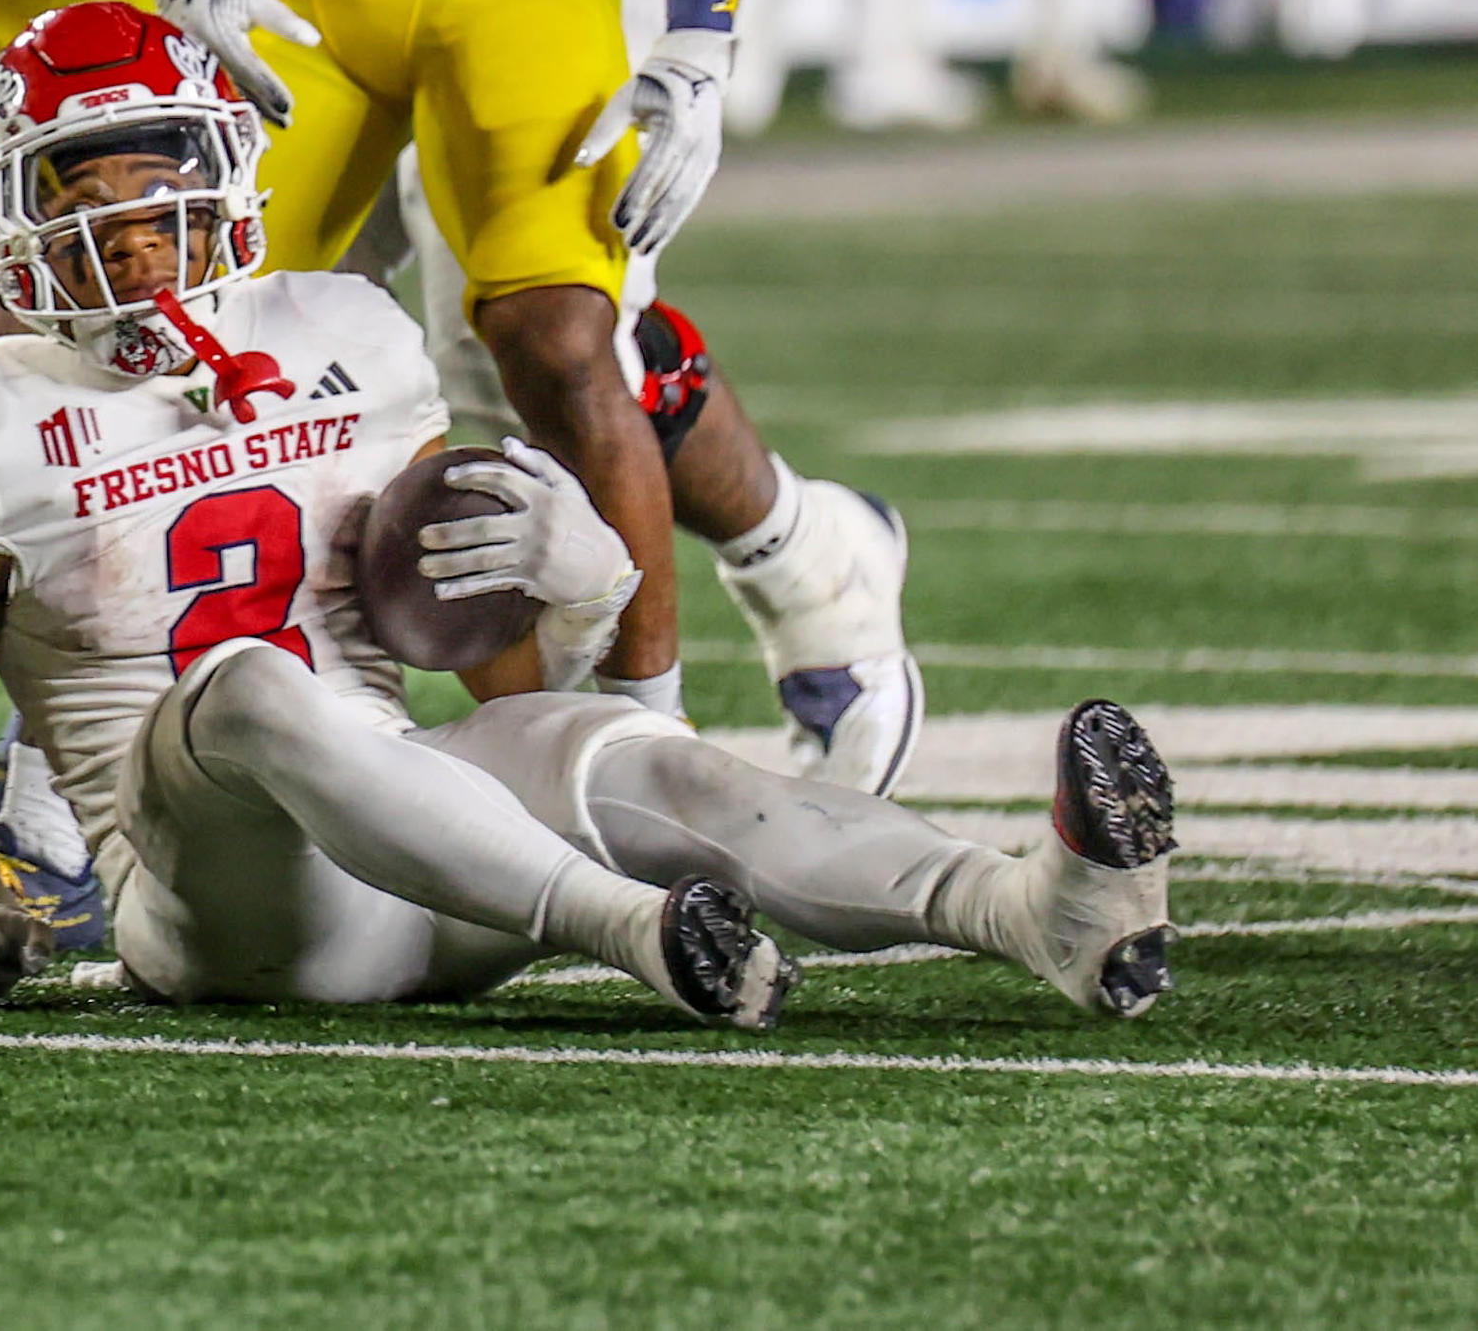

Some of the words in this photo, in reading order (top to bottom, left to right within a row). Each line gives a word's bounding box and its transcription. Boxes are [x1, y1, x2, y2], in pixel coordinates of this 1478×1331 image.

[73, 443, 236, 518] FRESNO
[245, 412, 362, 470] STATE
[166, 484, 314, 682] 2
